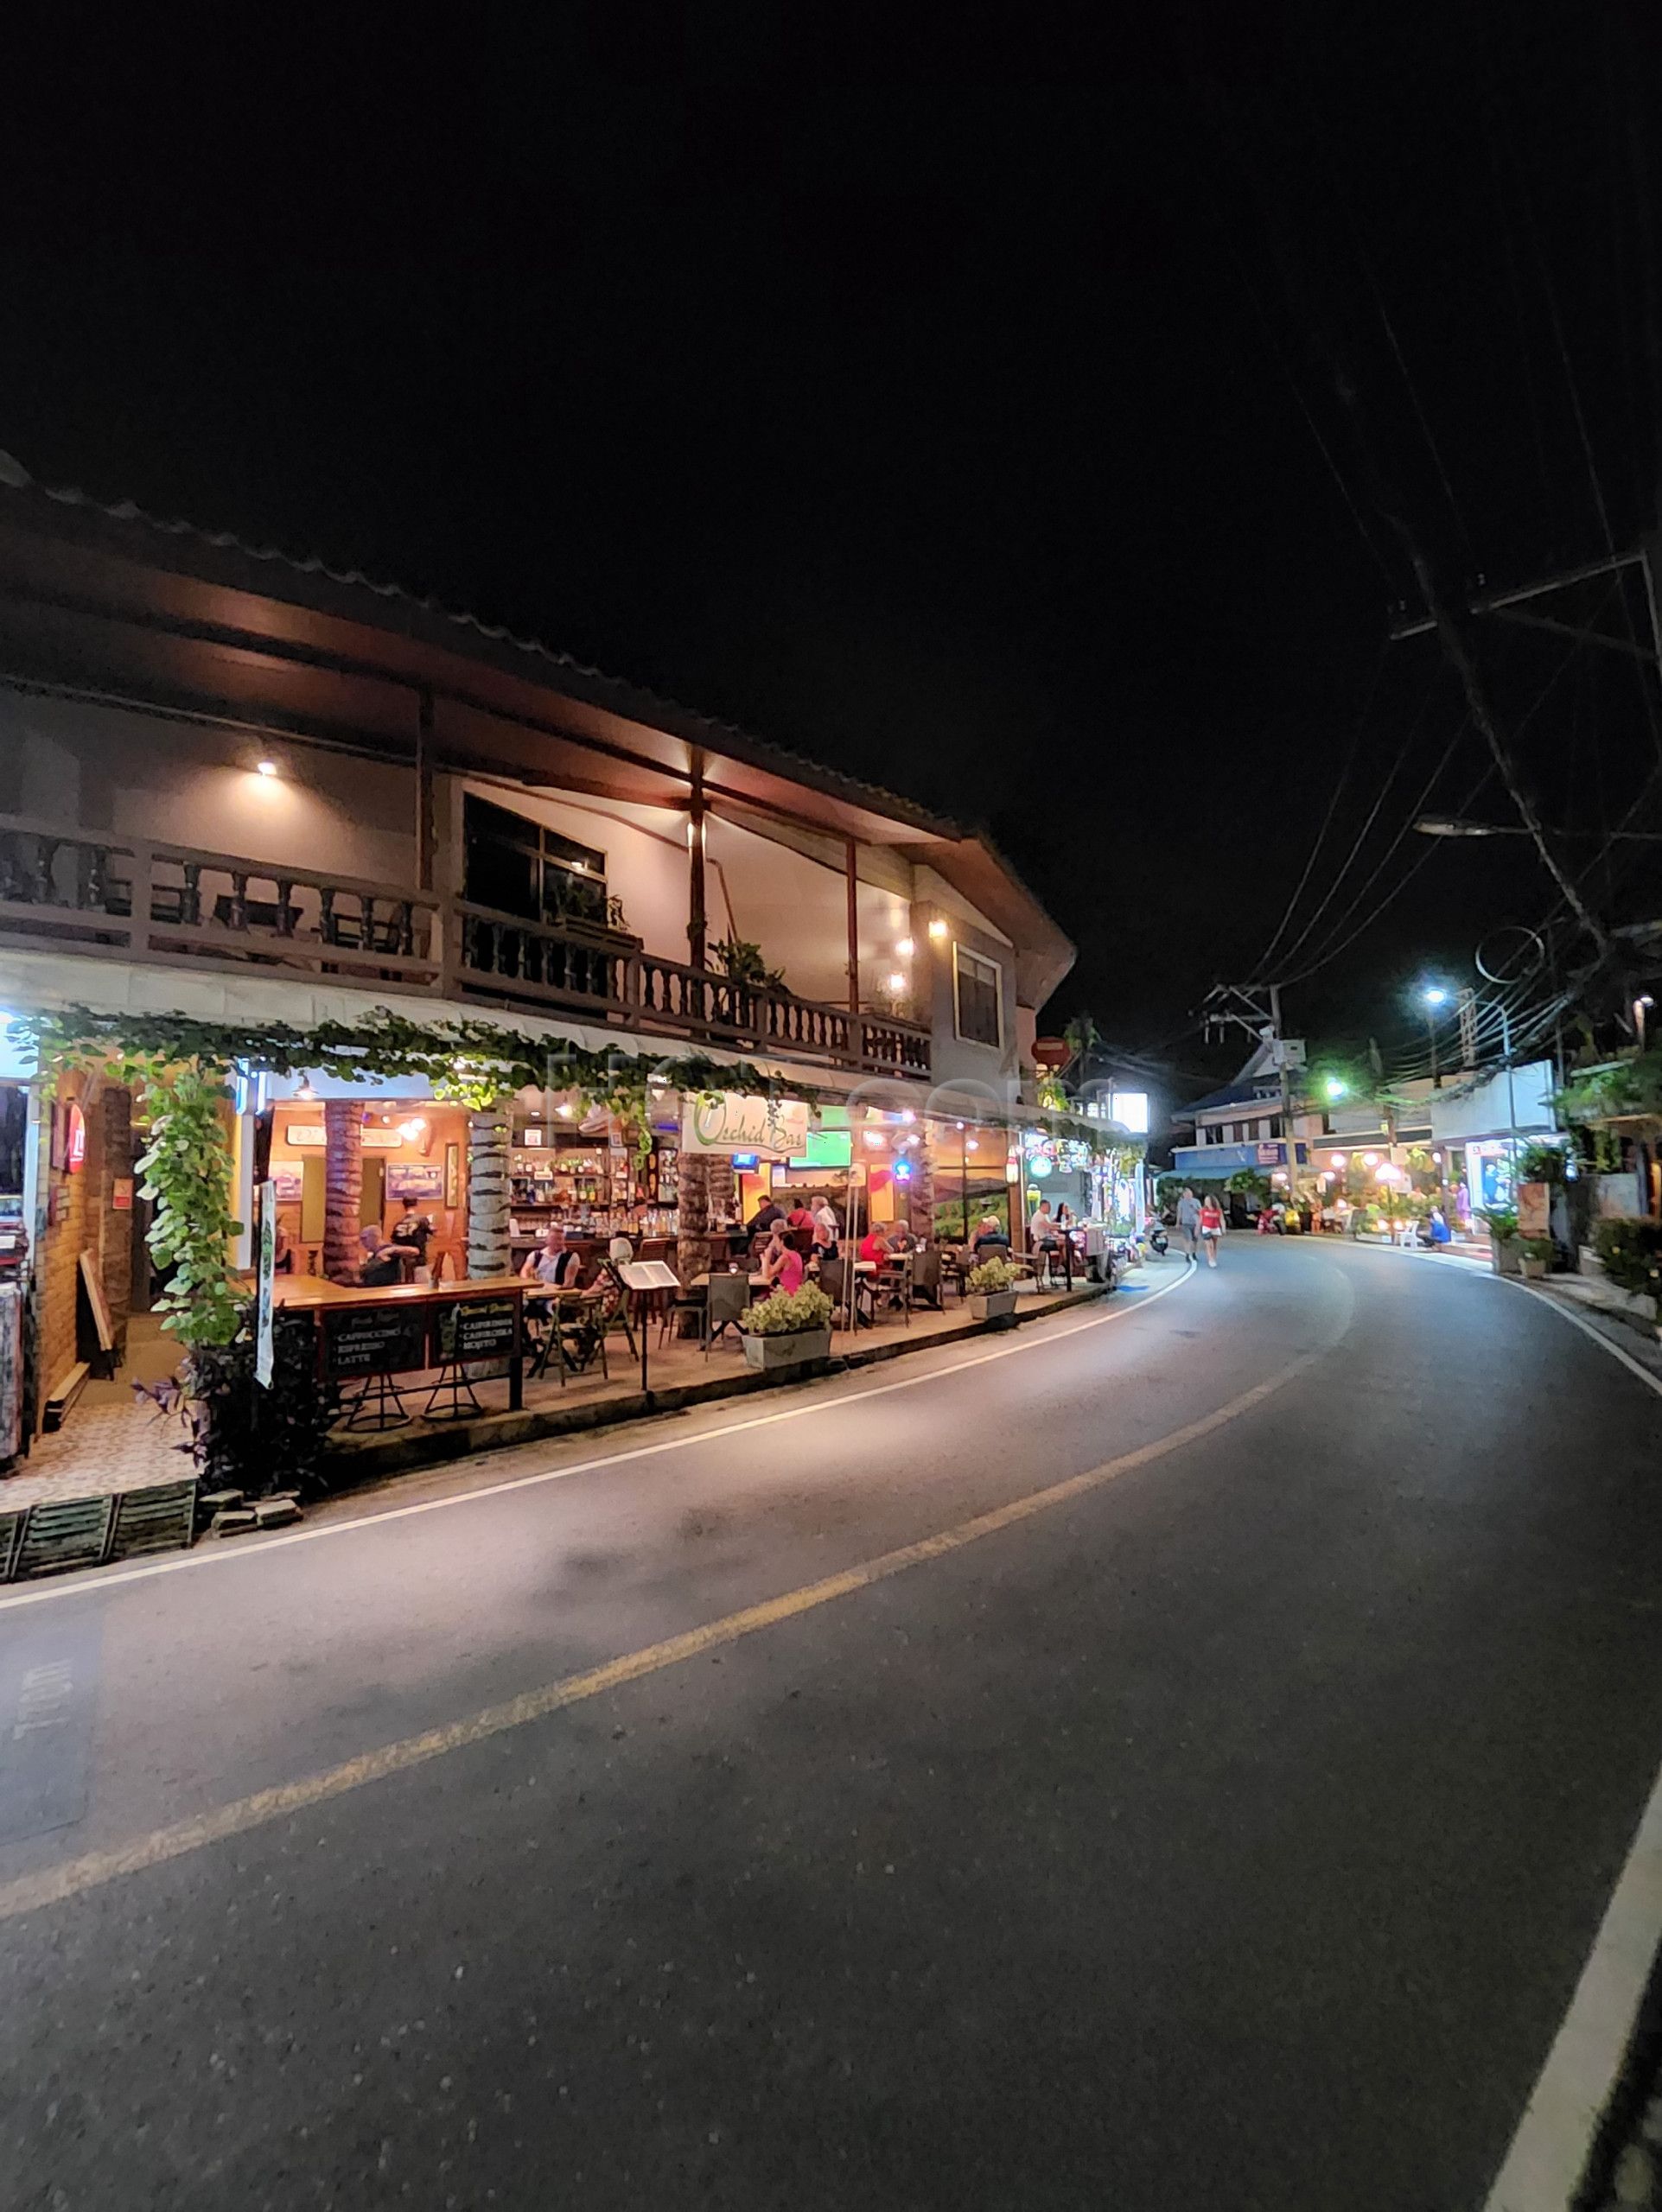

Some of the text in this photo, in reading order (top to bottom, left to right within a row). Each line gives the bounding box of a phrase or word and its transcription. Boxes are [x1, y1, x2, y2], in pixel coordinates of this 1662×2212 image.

[693, 1091, 803, 1150] Orchid Bar
[338, 1353, 371, 1365] LATTE
